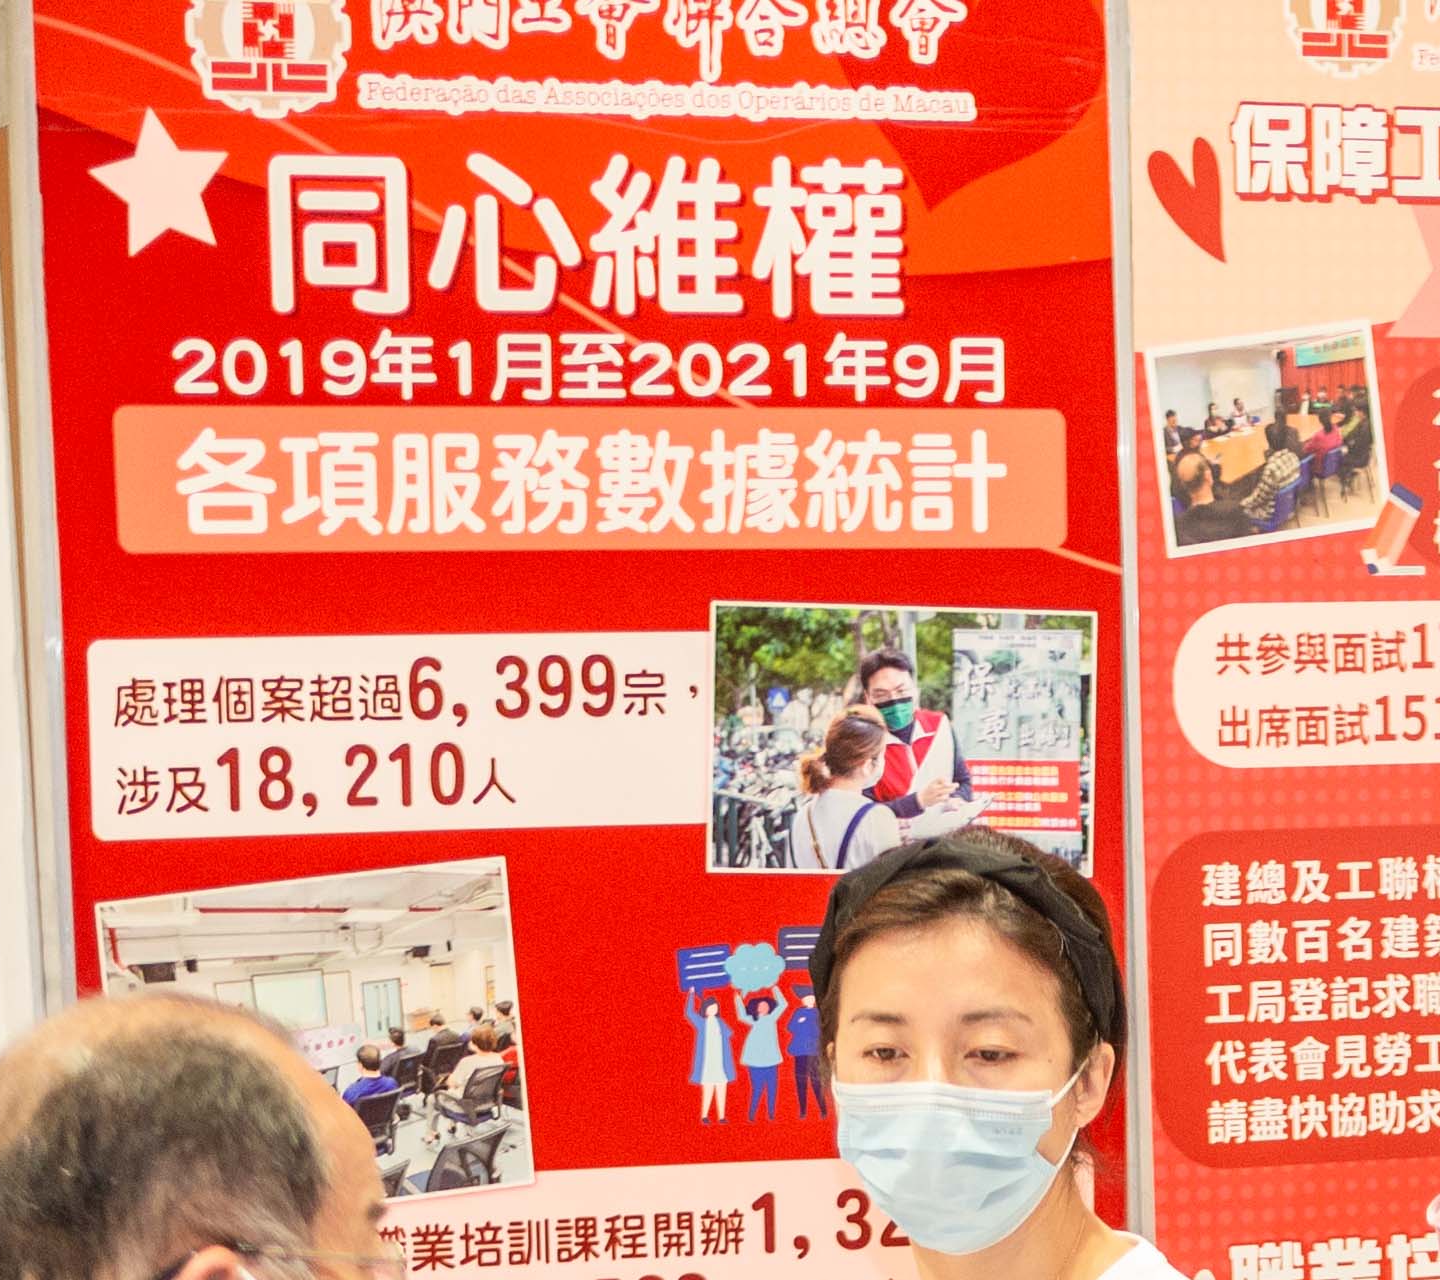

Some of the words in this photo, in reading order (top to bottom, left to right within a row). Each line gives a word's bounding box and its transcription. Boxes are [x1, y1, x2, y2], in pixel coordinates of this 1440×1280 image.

[495, 84, 539, 105] das
[691, 88, 731, 110] dos
[858, 92, 886, 112] de
[892, 93, 971, 115] Macau
[267, 151, 906, 319] 同心維權
[171, 328, 1006, 403] 2019年1月至2021年9月
[175, 426, 1008, 537] 各項服務數據統計
[116, 741, 517, 818] 涉及18,210人
